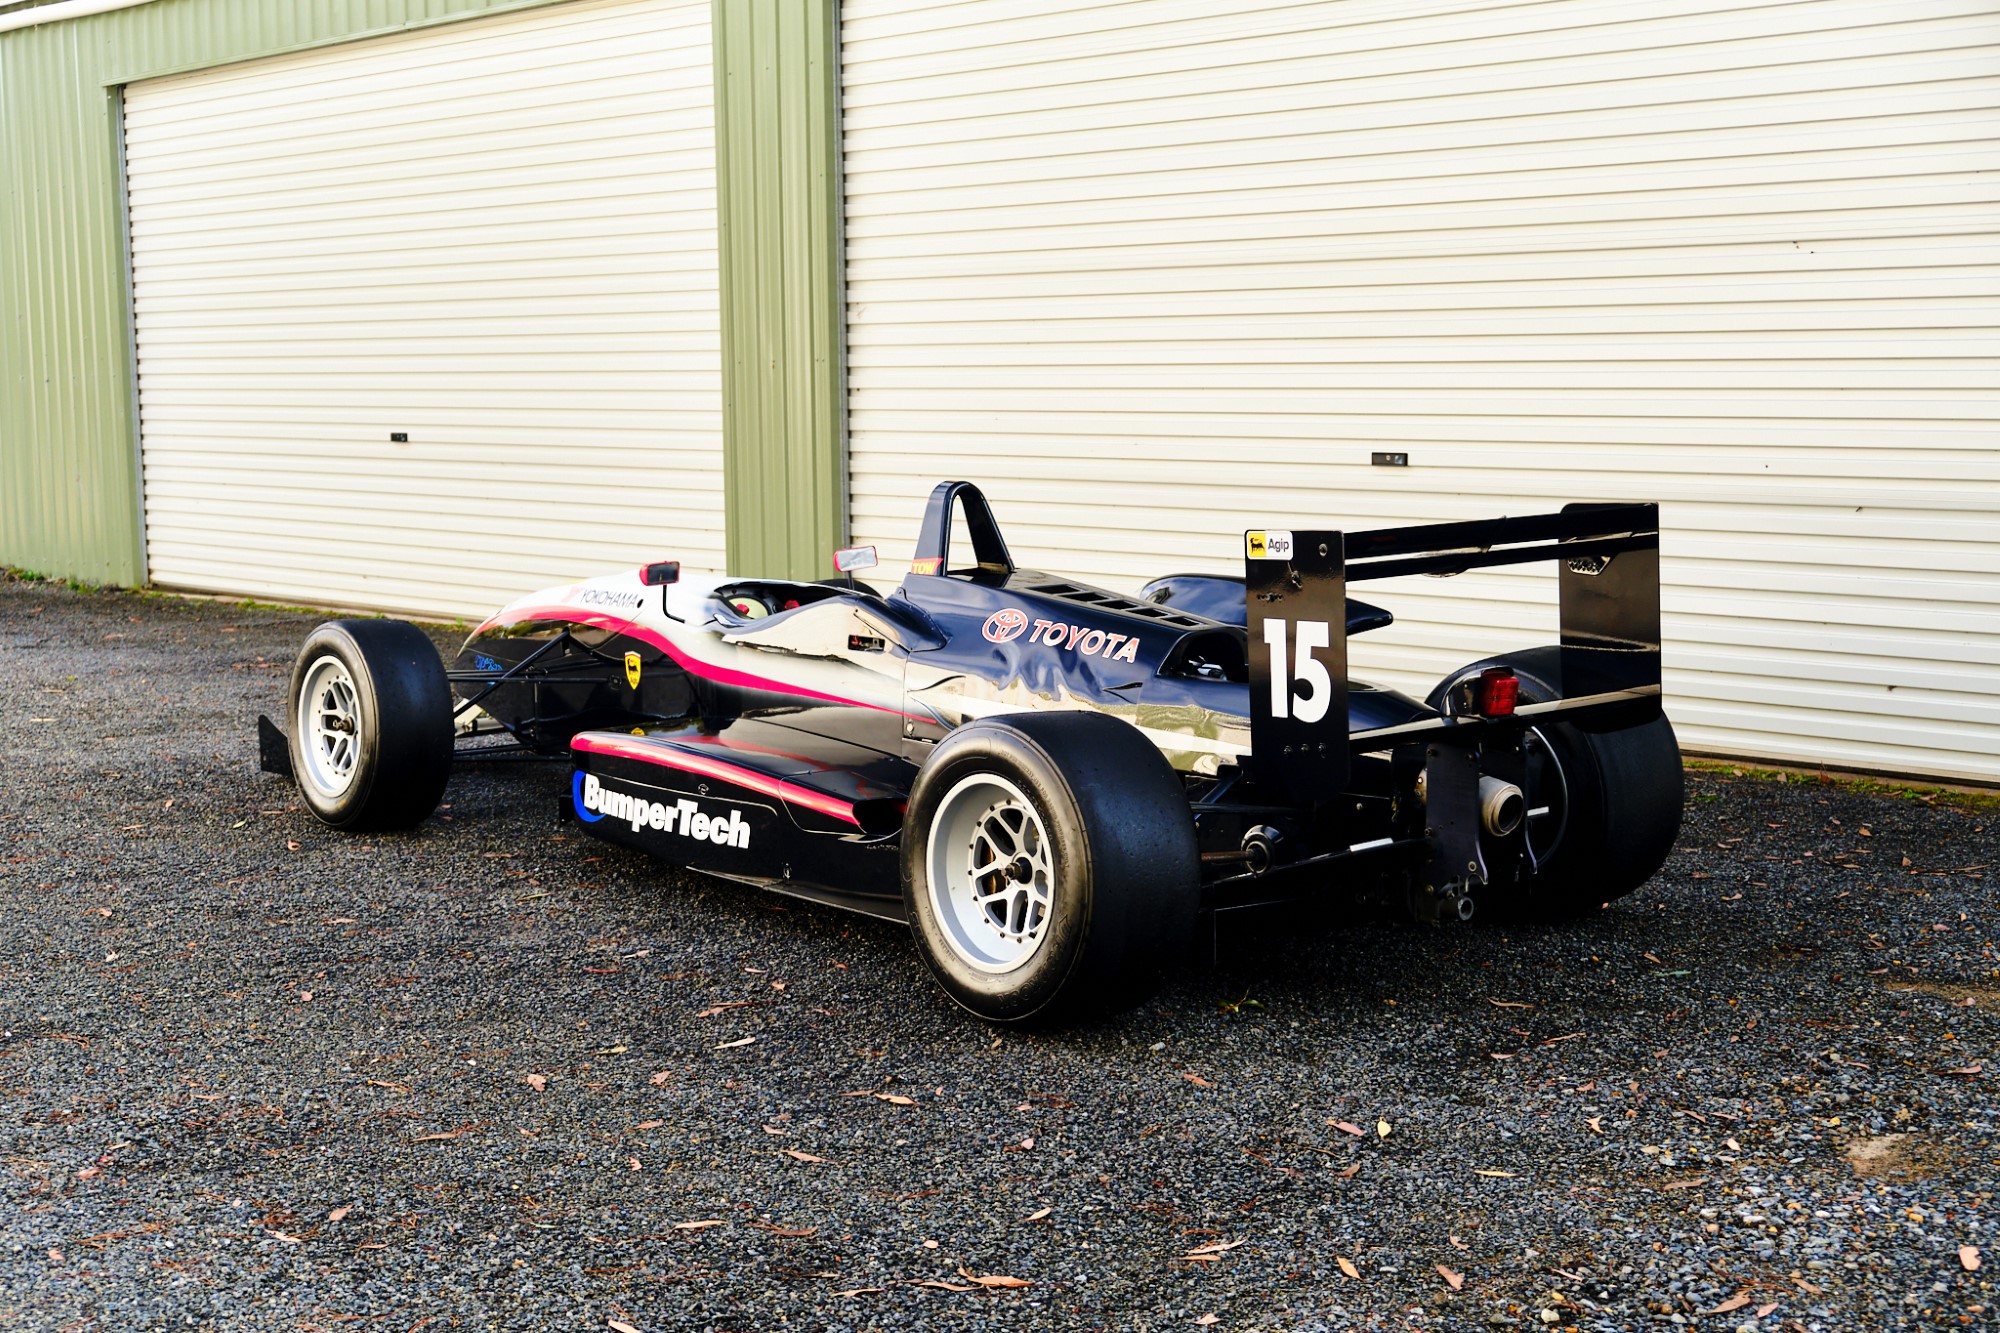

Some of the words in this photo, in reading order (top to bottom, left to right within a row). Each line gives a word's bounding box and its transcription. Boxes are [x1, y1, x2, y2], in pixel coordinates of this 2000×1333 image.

[1268, 538, 1290, 552] Agip
[912, 562, 936, 575] TOW
[580, 589, 639, 608] YOKOHAMA
[1028, 618, 1141, 663] TOYOTA
[1263, 617, 1332, 723] 15
[583, 773, 750, 849] BumperTech
